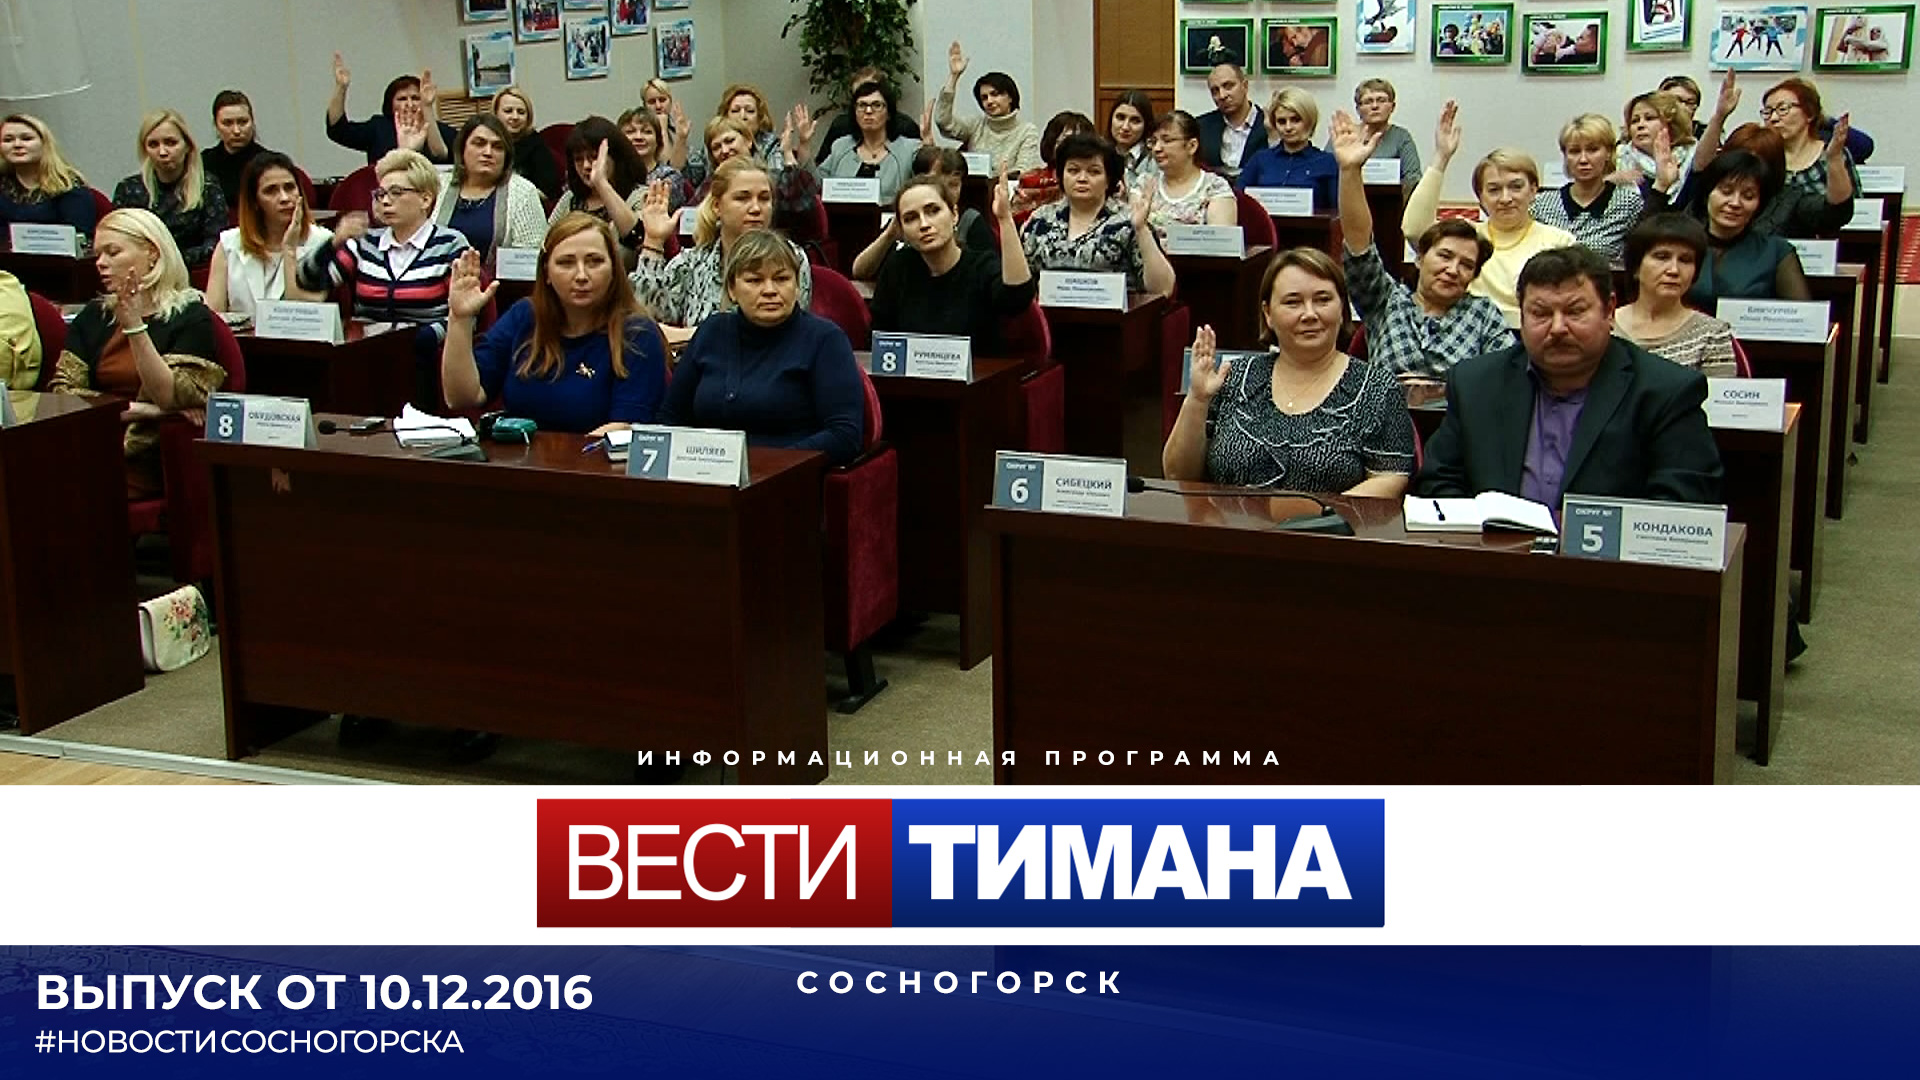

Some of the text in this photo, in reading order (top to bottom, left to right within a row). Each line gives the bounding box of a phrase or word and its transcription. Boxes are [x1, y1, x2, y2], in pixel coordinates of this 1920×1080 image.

[882, 352, 897, 372] 8
[1723, 390, 1761, 400] СОСИН
[218, 414, 233, 437] 8
[642, 448, 659, 472] 7
[1010, 478, 1029, 504] 6
[1581, 523, 1604, 553] 5
[1633, 521, 1713, 538] КОНДАКОВА
